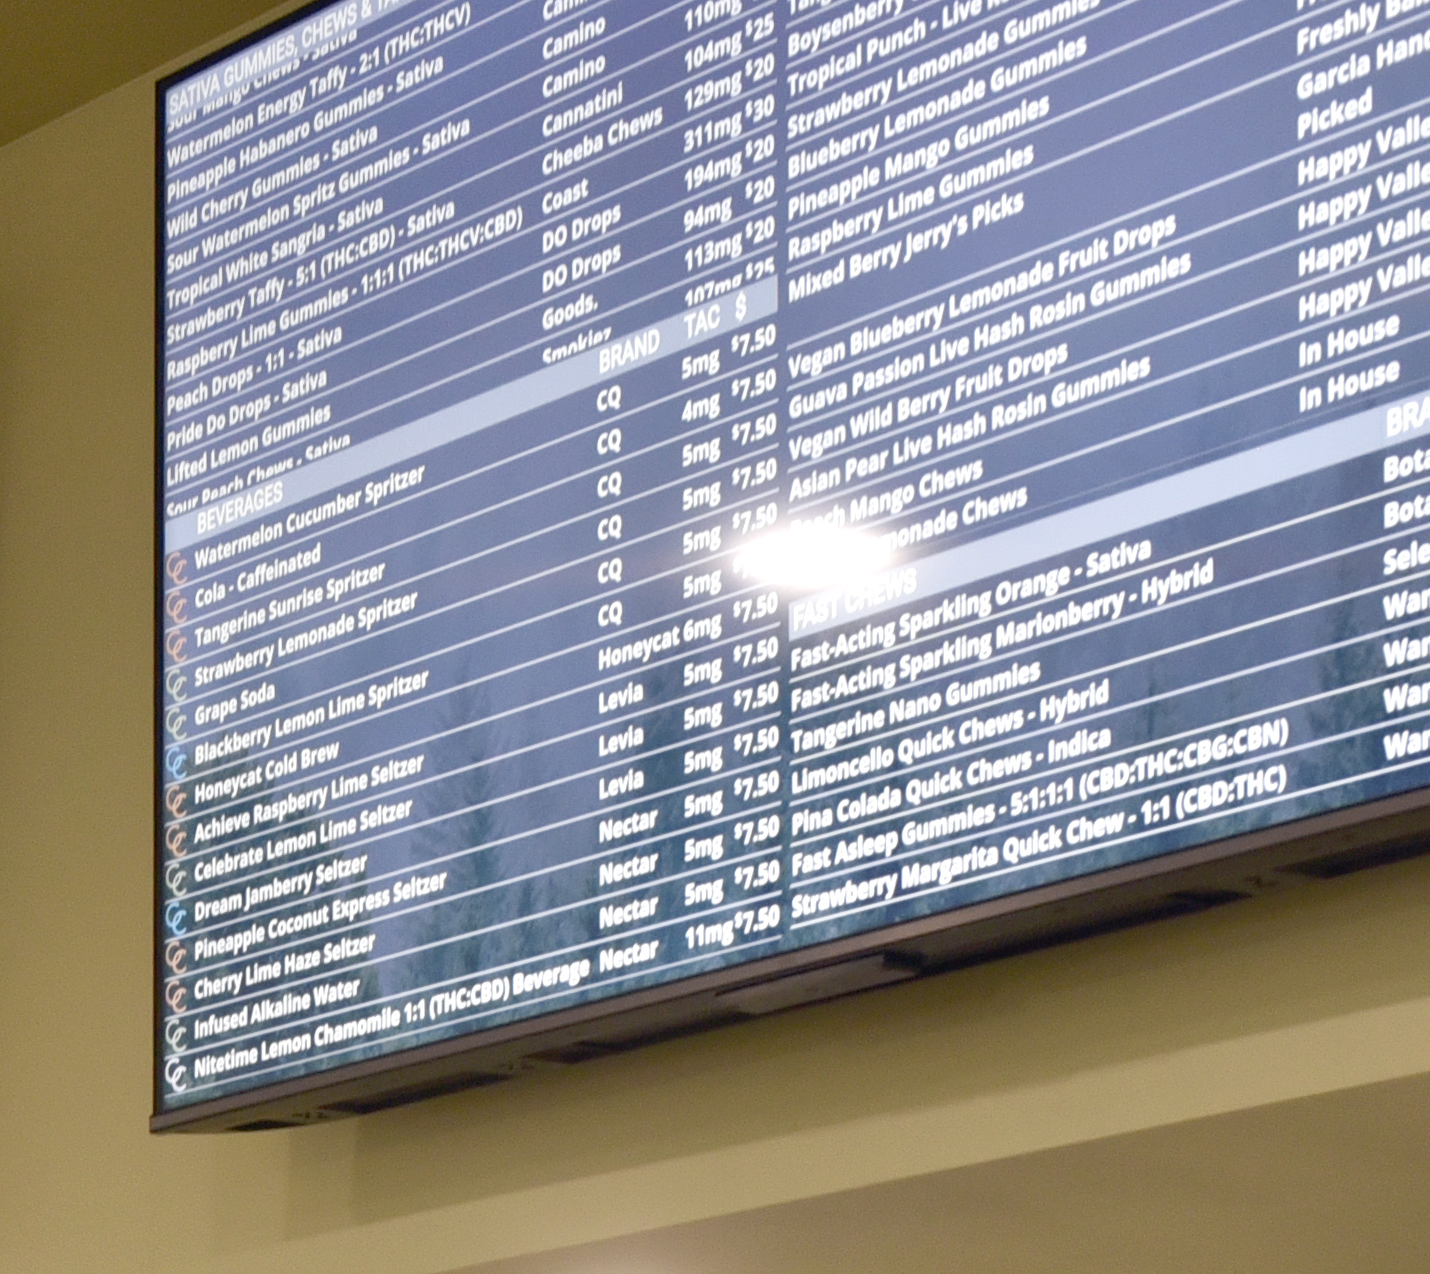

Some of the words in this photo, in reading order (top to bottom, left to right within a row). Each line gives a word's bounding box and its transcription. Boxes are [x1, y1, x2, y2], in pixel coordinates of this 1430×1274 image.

[1297, 53, 1370, 100] Garcia
[1298, 86, 1372, 140] Picked
[542, 134, 603, 175] Cheeba
[608, 107, 662, 145] Chews
[789, 259, 845, 302] Mixed
[850, 241, 902, 278] Berry
[903, 214, 968, 263] Jerry's
[973, 193, 1024, 230] Picks
[1299, 231, 1372, 276] Happy
[684, 304, 720, 339] TAC
[735, 291, 747, 322] $
[599, 329, 660, 374] BRAND
[682, 349, 720, 379] 5mg
[732, 324, 776, 357] $7.50
[597, 385, 621, 412] CQ
[789, 425, 846, 460] Vegan
[850, 402, 892, 438] Wild
[897, 385, 951, 422] Berry
[955, 364, 1003, 401] Fruit
[1008, 343, 1068, 382] Drops
[195, 522, 282, 569] Watermelon
[286, 491, 362, 533] Cucumber
[365, 465, 425, 506] Spritzer
[198, 481, 283, 534] BEVERAGES
[195, 608, 266, 647] Tangerine
[269, 587, 323, 620] Sunrise
[326, 563, 385, 602] Spritzer
[195, 644, 274, 687] Strawberry
[278, 613, 354, 657] Lemonade
[358, 592, 418, 631] Spritzer
[599, 682, 643, 714] Levia
[791, 710, 885, 753] Tangerine
[889, 692, 942, 724] Nano
[946, 662, 1040, 706] Gummies
[194, 812, 250, 843] Achieve
[254, 786, 328, 824] Raspberry
[331, 774, 368, 800] Lime
[371, 754, 424, 787] Seltzer
[599, 897, 658, 929] Nectar
[195, 1005, 248, 1039] Infused
[250, 993, 311, 1024] Alkaline
[313, 979, 360, 1007] Water
